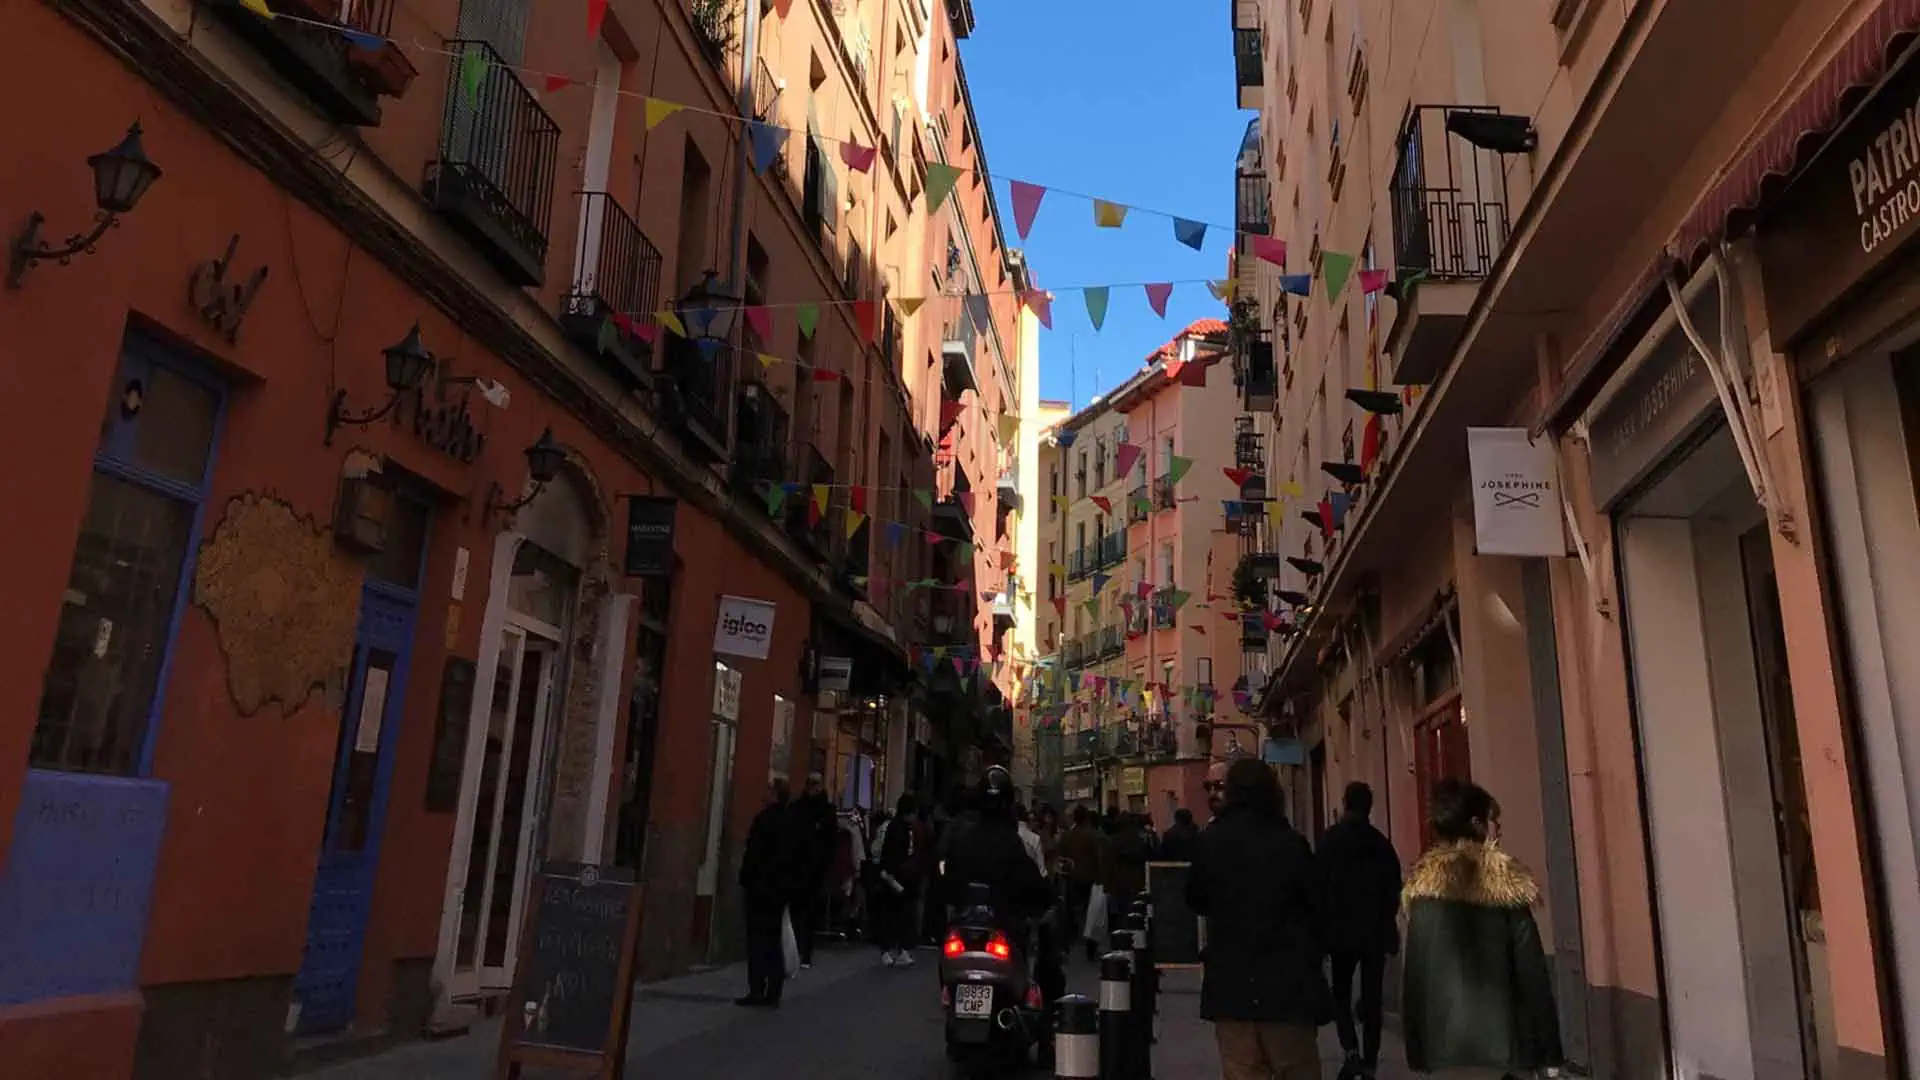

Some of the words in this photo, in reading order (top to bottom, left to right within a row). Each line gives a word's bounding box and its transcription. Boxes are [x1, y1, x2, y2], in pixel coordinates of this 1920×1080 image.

[1861, 180, 1920, 252] CASTRO
[1480, 480, 1551, 490] JOSEPHINE
[722, 612, 767, 636] igloo
